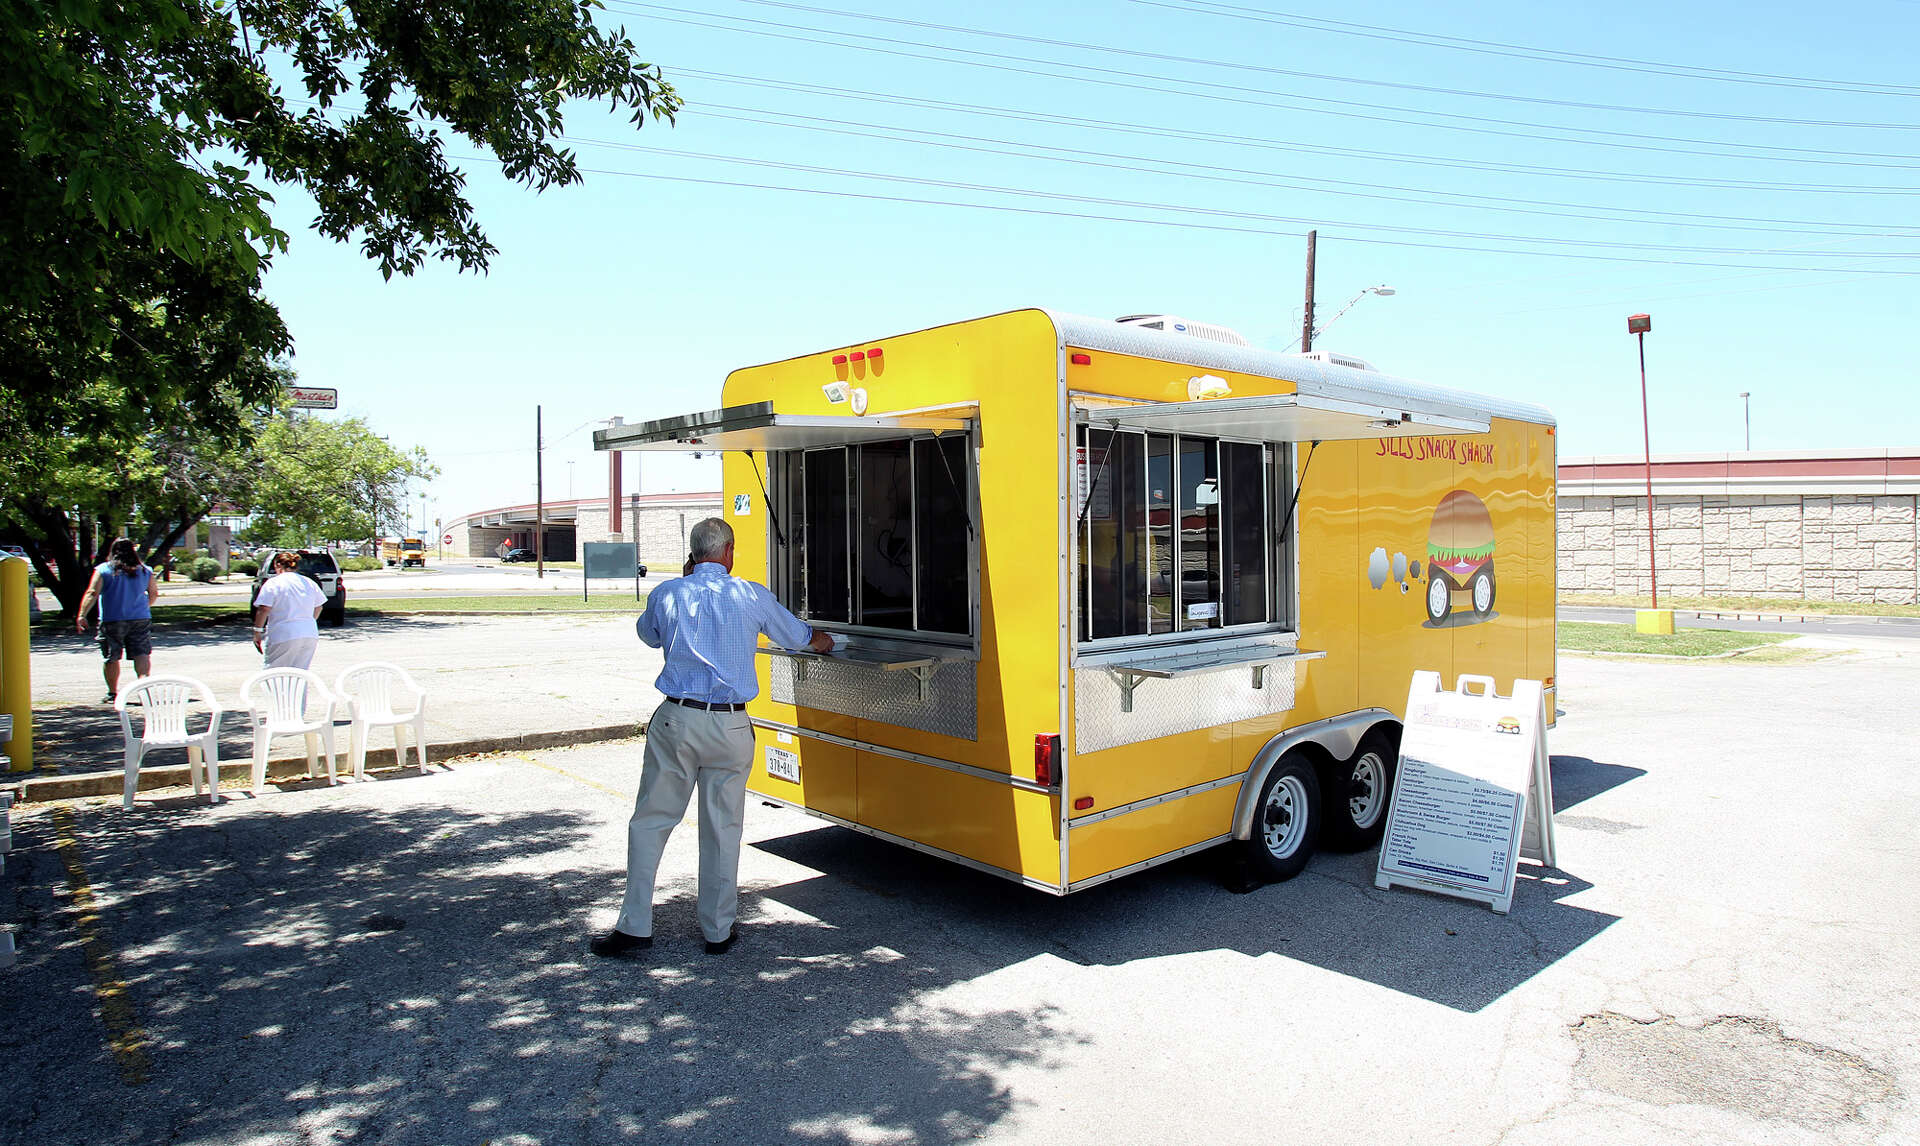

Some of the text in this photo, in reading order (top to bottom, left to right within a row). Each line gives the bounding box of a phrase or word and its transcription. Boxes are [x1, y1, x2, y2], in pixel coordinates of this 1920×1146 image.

[1416, 436, 1456, 461] SNACK
[1459, 441, 1494, 465] SHACK
[775, 749, 788, 757] TEXAS
